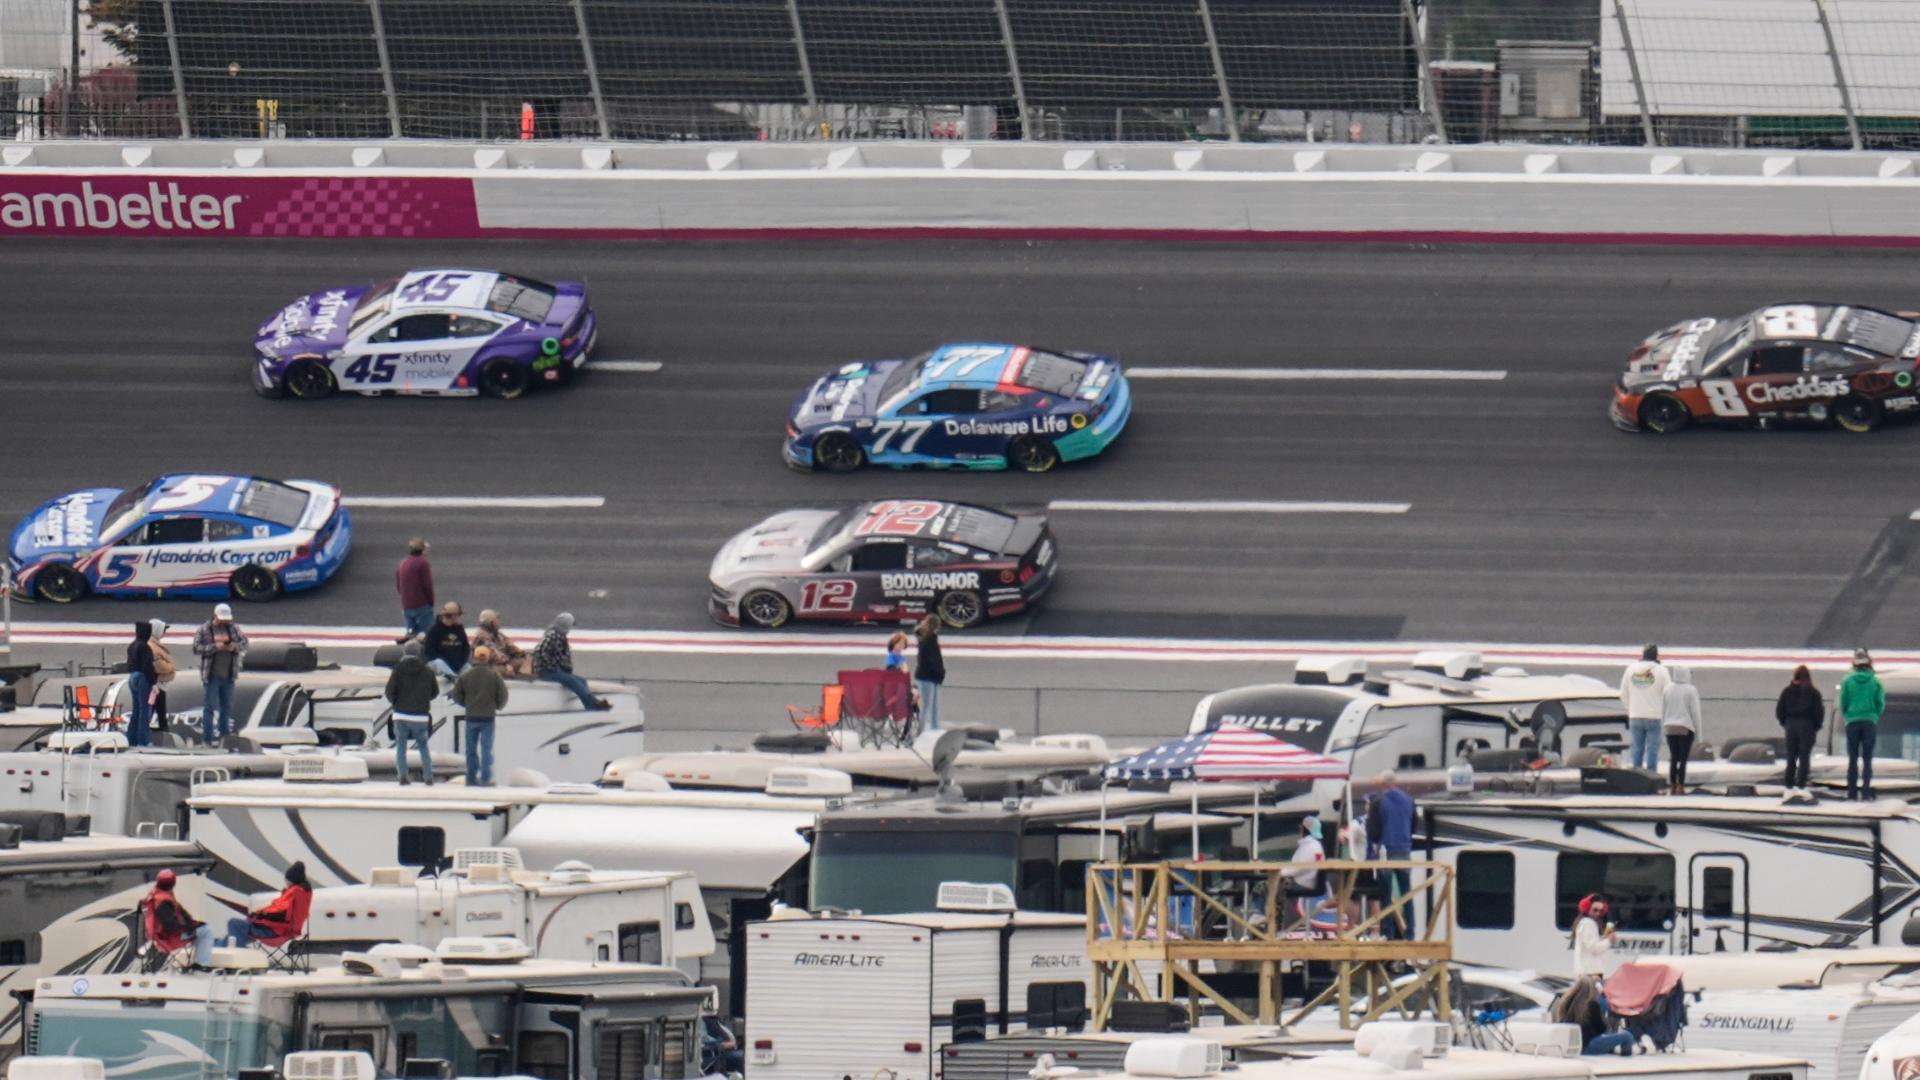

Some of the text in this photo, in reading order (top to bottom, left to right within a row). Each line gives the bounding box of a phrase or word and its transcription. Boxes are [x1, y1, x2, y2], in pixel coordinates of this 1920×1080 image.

[1, 181, 242, 230] ambetter
[398, 273, 473, 302] 45
[1761, 304, 1818, 337] 8
[344, 353, 401, 384] 45
[404, 352, 452, 365] xfinity
[928, 346, 1008, 379] 77
[1701, 380, 1749, 417] 8
[1746, 374, 1850, 403] Cheddar's
[872, 420, 932, 454] 77
[945, 415, 1068, 436] Delaware Life
[152, 475, 230, 510] 5
[855, 501, 943, 535] 12
[98, 553, 142, 587] 5
[881, 572, 980, 590] BODYARMOR
[800, 580, 857, 612] 12
[794, 952, 886, 968] AMERI-LITE
[1699, 1012, 1796, 1032] SPRINGDALE
